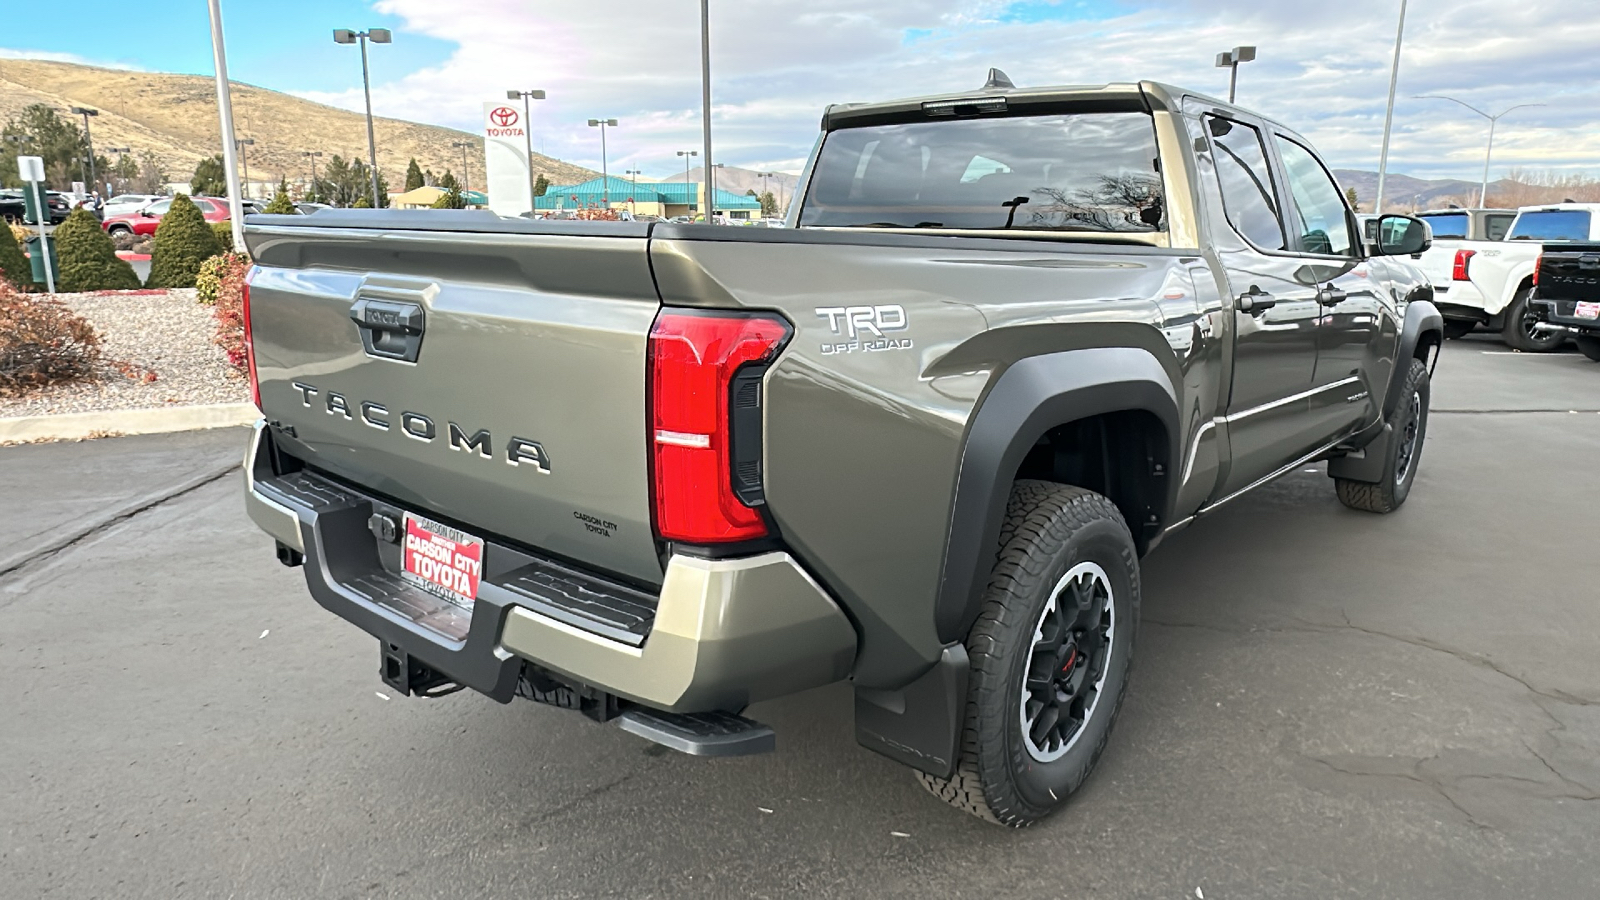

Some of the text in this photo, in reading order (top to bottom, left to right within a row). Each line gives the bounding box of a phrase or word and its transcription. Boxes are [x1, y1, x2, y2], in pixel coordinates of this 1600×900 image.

[486, 128, 524, 137] TOYOTA
[815, 304, 907, 338] TRD
[821, 339, 914, 355] OFF ROAD
[292, 381, 551, 475] TACOMA
[420, 518, 464, 542] CARSON CITY
[573, 511, 618, 531] CARSON CITY
[584, 523, 611, 538] TOYOTA
[406, 534, 480, 576] CARSON CITY
[412, 551, 472, 597] TOYOTA
[422, 578, 457, 602] TOYOTA
